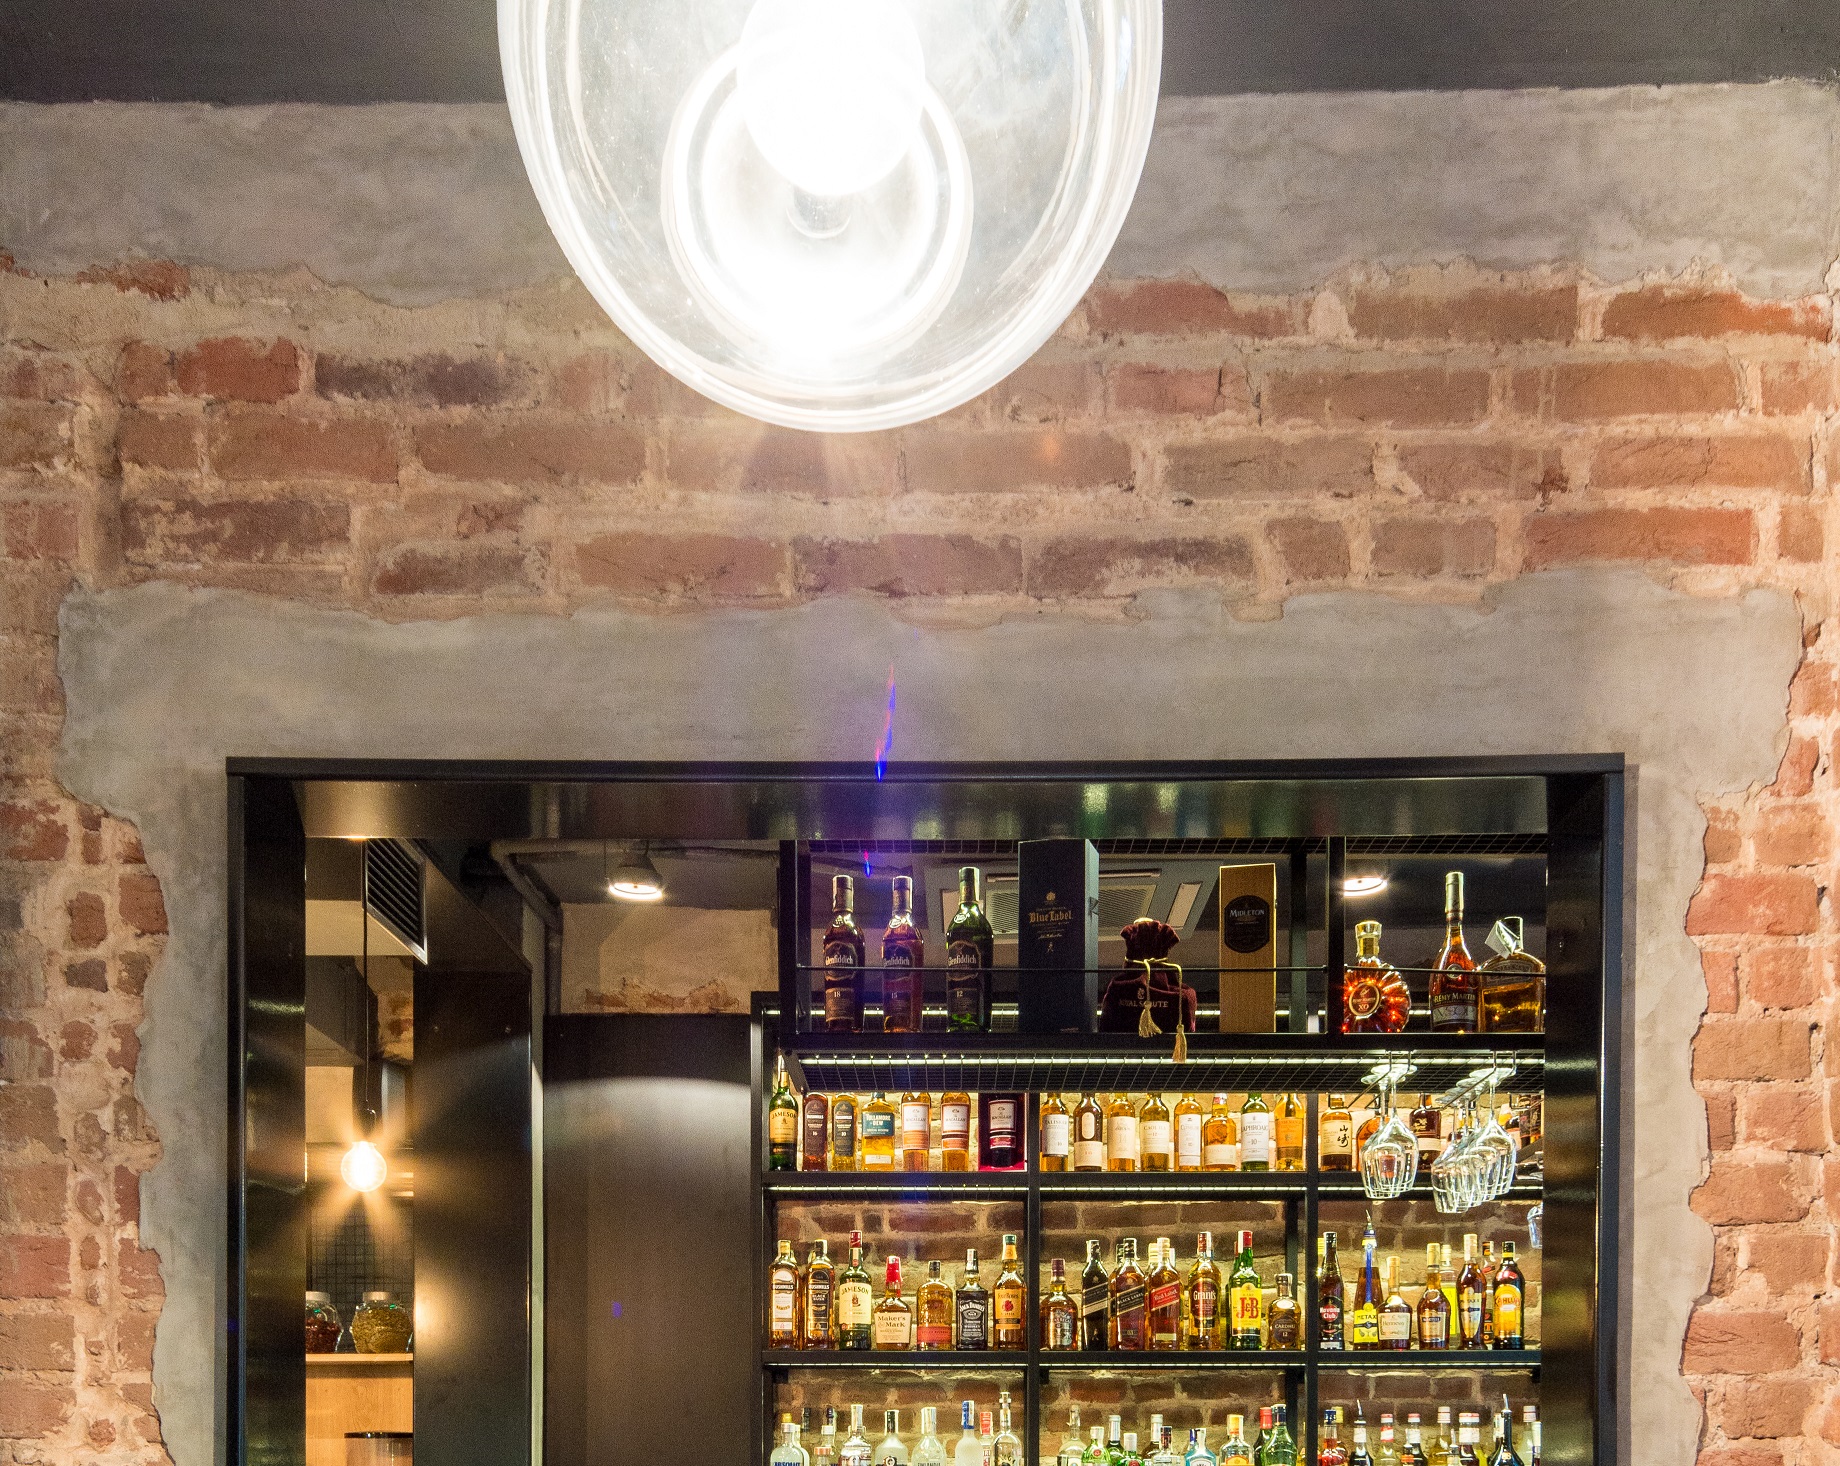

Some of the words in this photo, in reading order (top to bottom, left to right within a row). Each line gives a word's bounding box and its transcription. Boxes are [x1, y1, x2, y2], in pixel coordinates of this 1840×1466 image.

[1028, 912, 1049, 923] Blue
[1049, 910, 1072, 921] Label
[1229, 909, 1265, 917] MIDLETON
[1358, 1003, 1370, 1011] XO
[841, 1286, 869, 1295] JAMESON
[1193, 1289, 1216, 1301] Grant's
[1236, 1297, 1259, 1319] J&B
